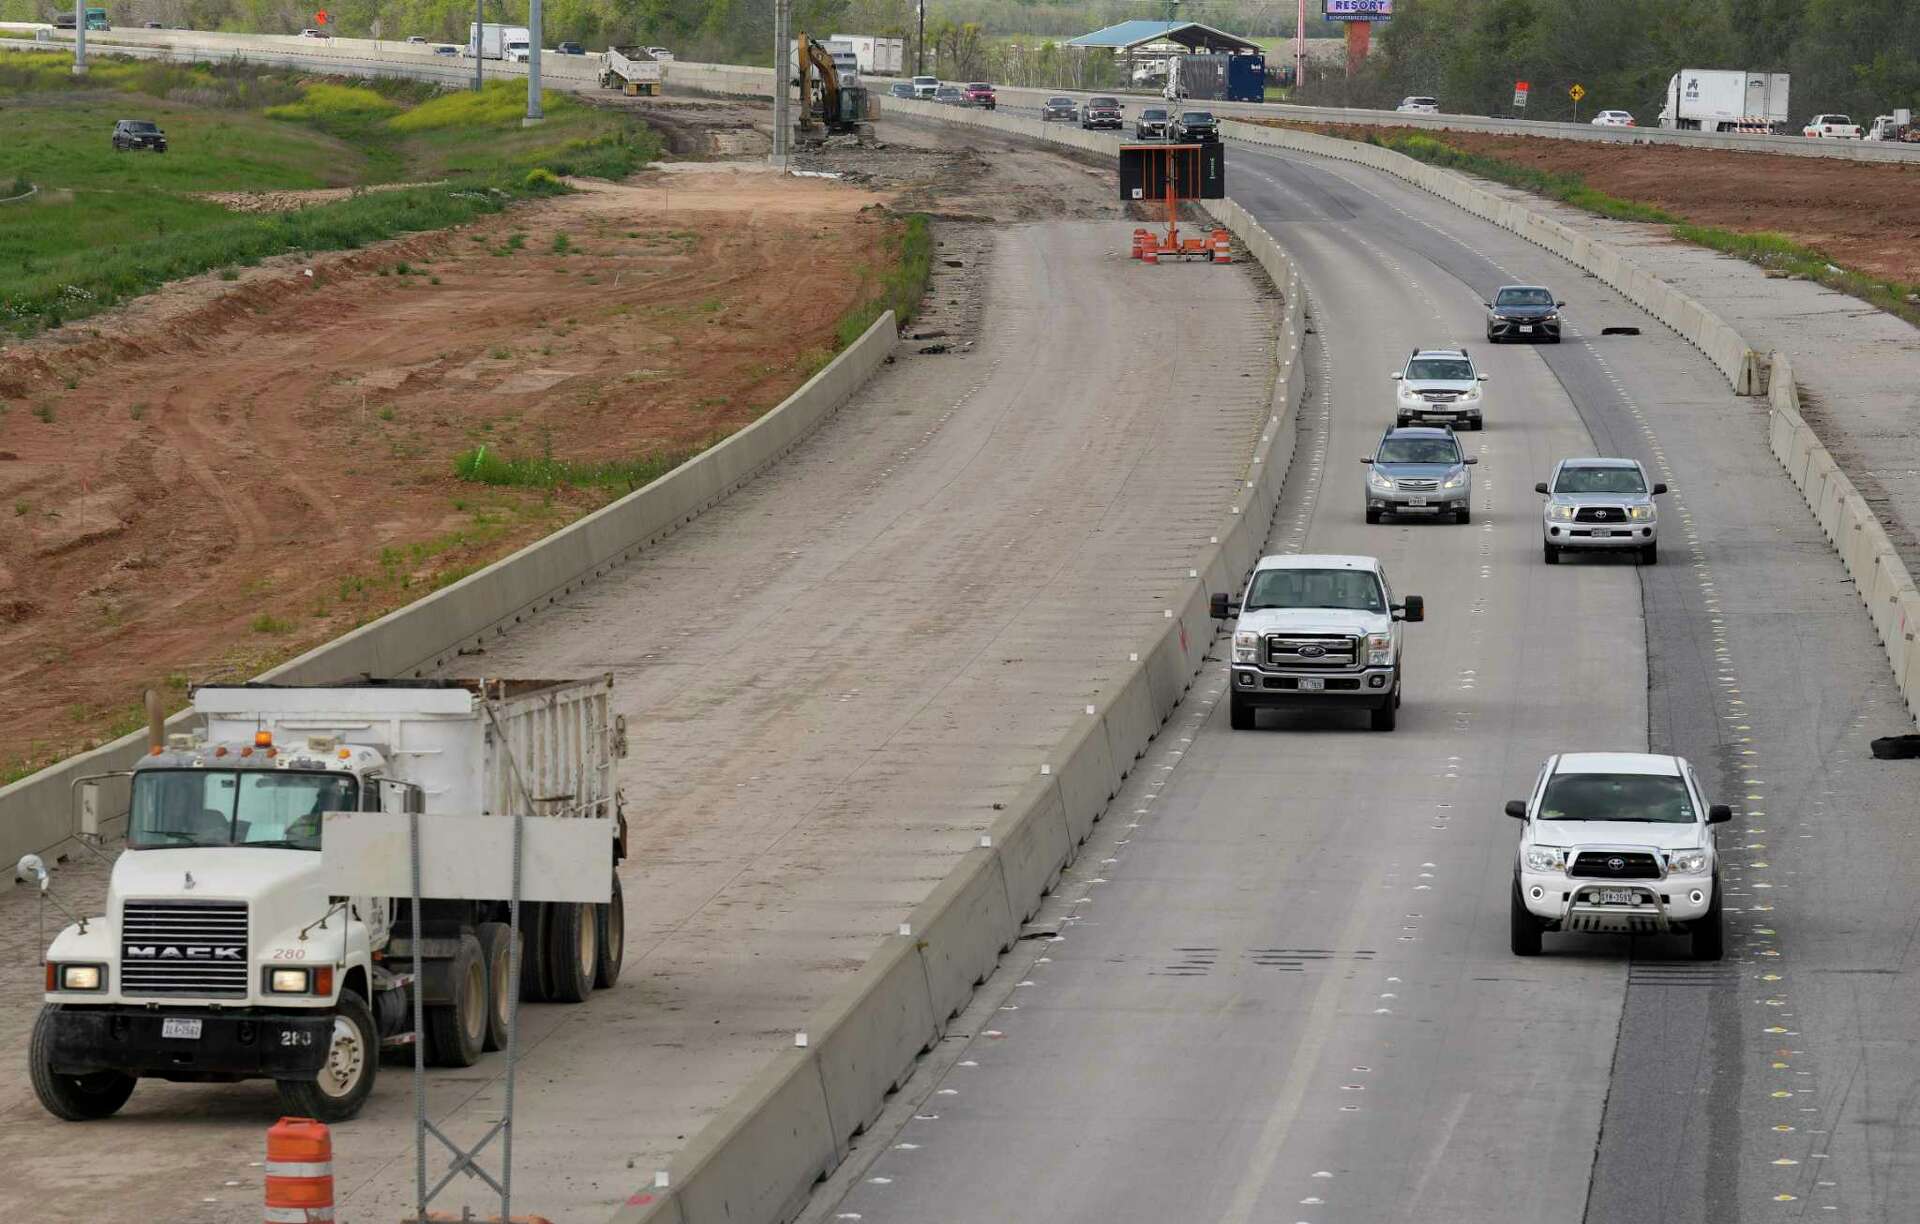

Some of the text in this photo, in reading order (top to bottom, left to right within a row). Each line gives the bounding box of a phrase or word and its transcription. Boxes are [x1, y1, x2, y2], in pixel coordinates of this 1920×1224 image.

[1335, 1, 1384, 10] RESORT
[128, 946, 241, 959] MACK
[273, 949, 305, 960] 280
